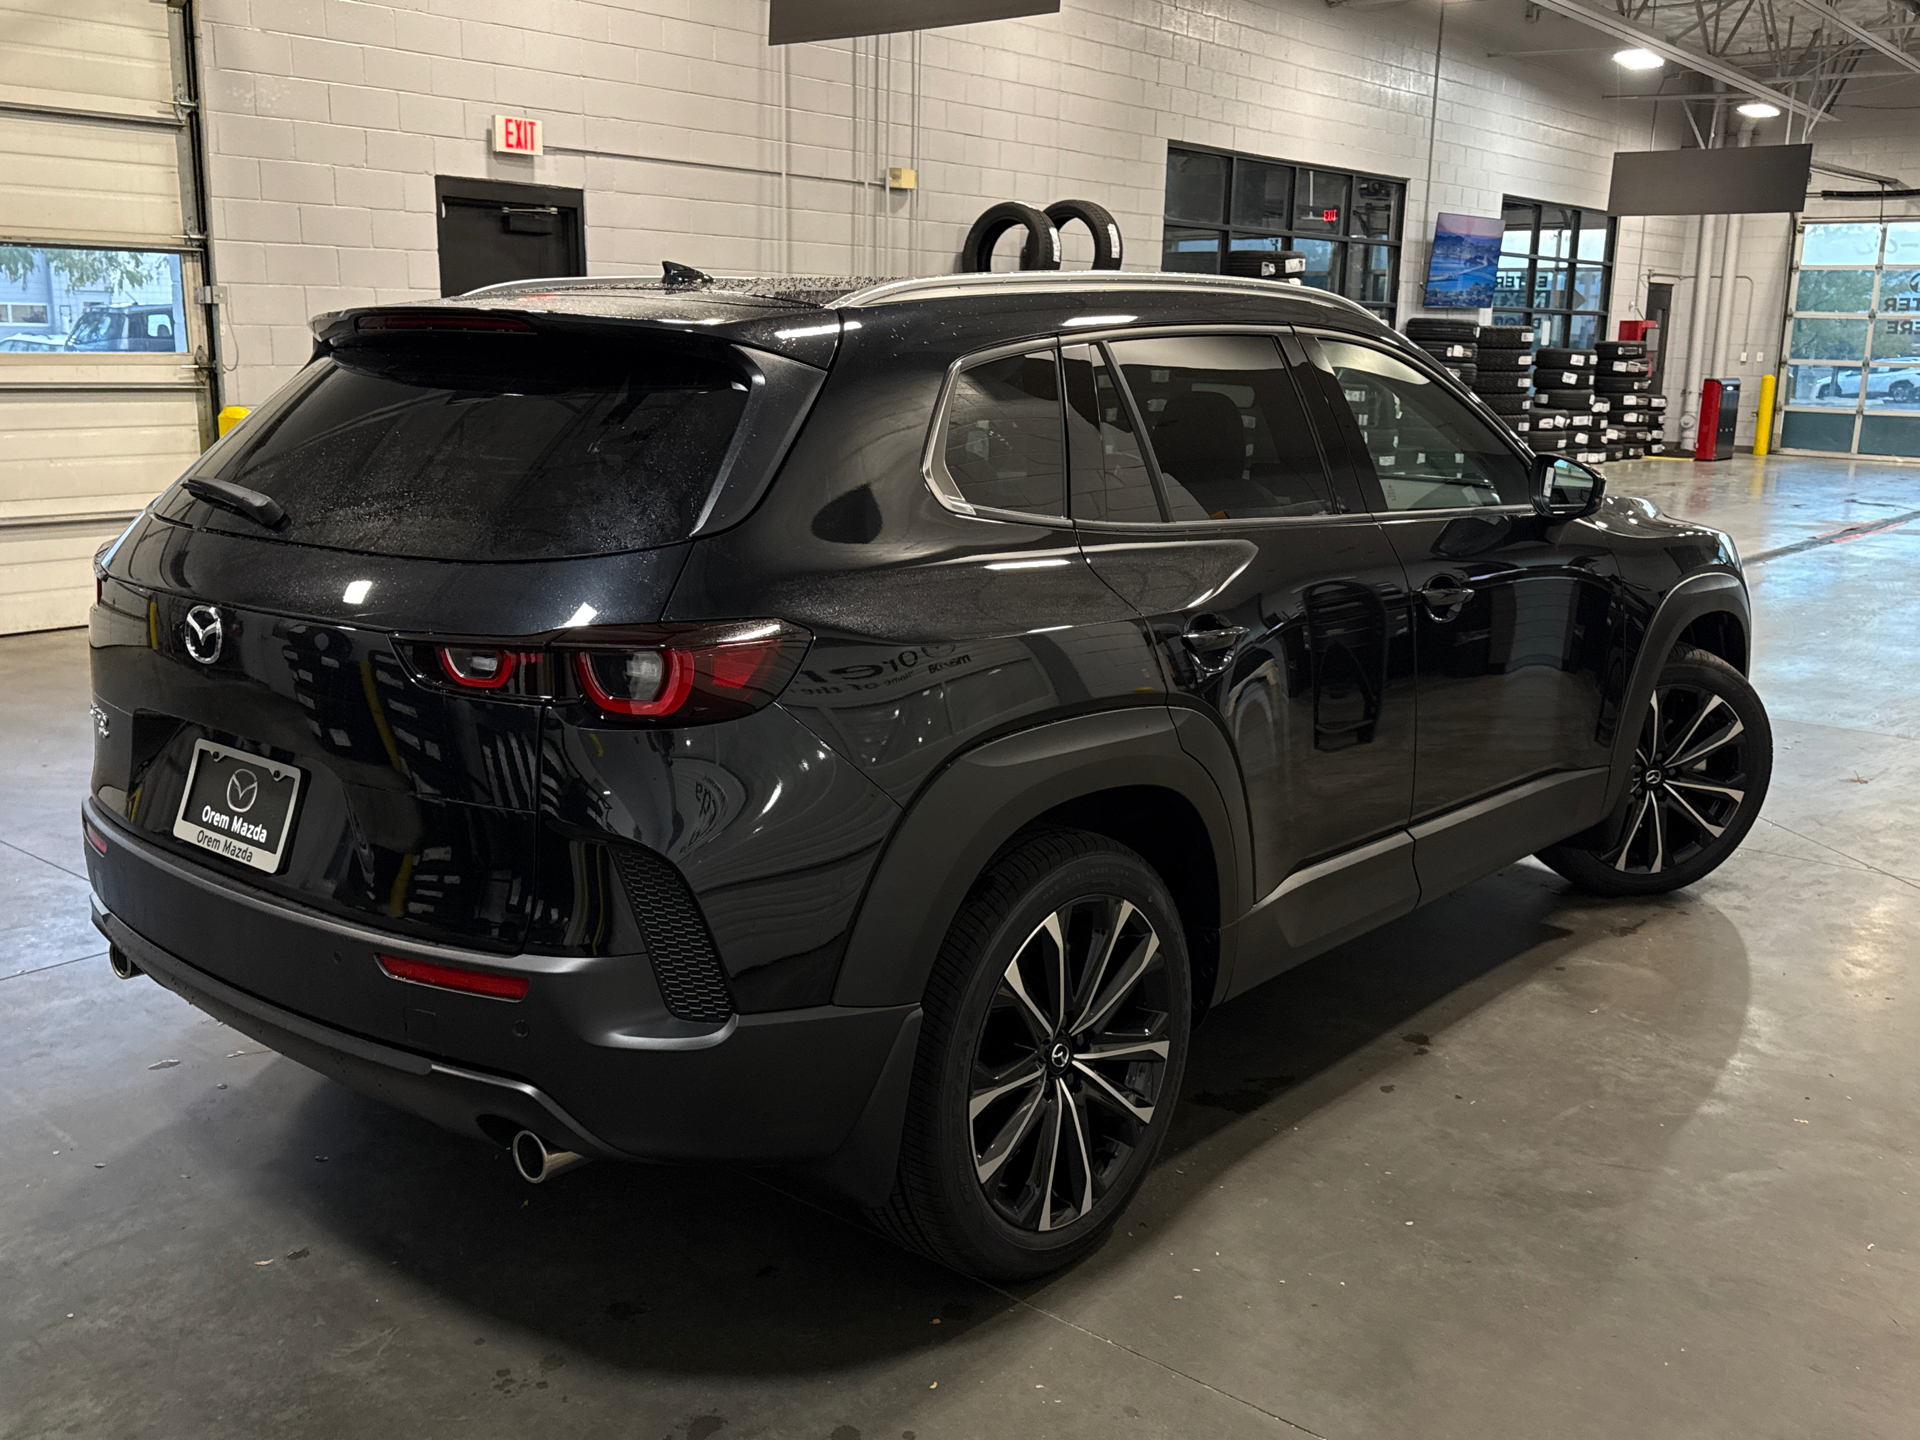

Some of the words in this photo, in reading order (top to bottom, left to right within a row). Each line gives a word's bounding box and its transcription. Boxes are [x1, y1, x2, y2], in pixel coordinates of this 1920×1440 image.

[505, 118, 536, 151] EXIT
[202, 805, 229, 830] Orem
[231, 815, 267, 843] Mazda
[197, 830, 221, 850] Orem
[222, 839, 253, 862] Mazda
